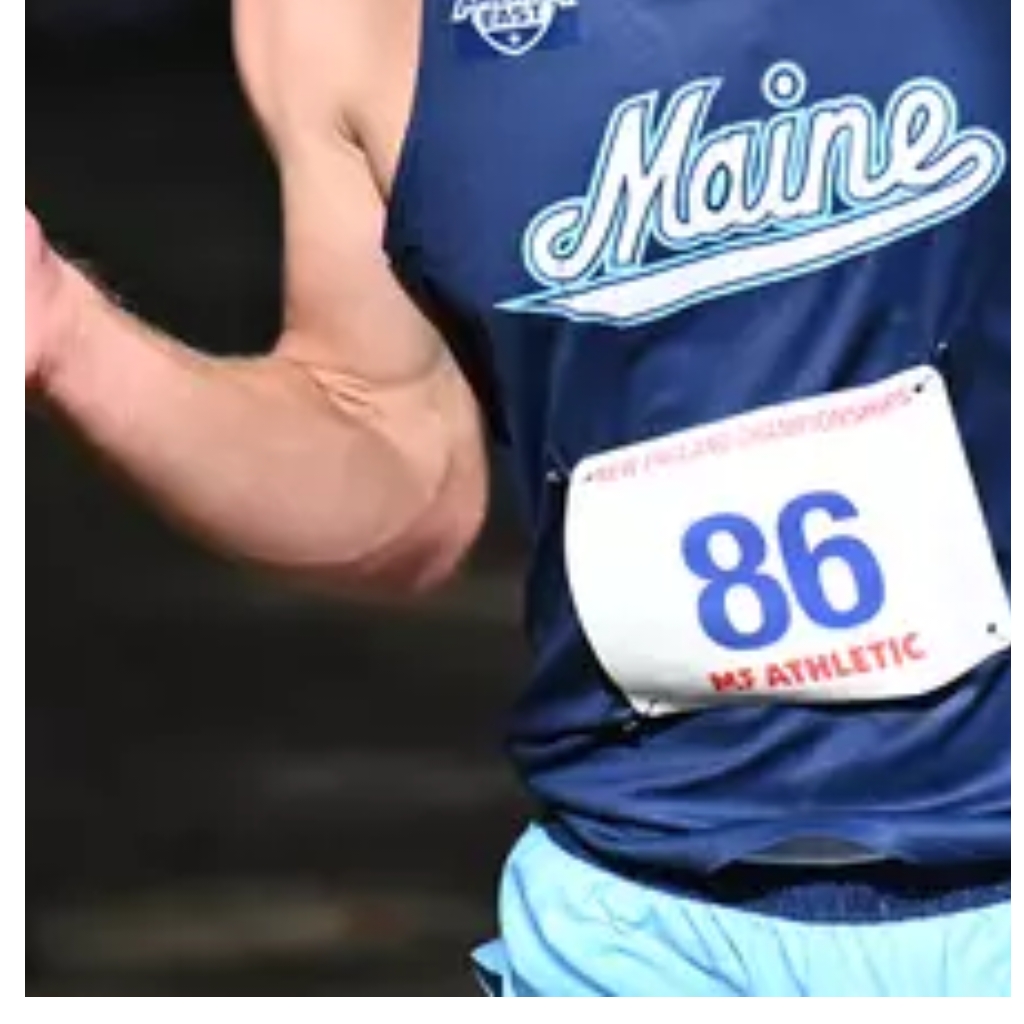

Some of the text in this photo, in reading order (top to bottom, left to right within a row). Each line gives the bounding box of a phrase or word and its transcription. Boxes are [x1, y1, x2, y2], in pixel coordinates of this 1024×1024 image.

[480, 4, 542, 30] EAST
[522, 61, 1005, 289] Maine
[681, 489, 885, 651] 86
[765, 631, 927, 688] ATHLETIC
